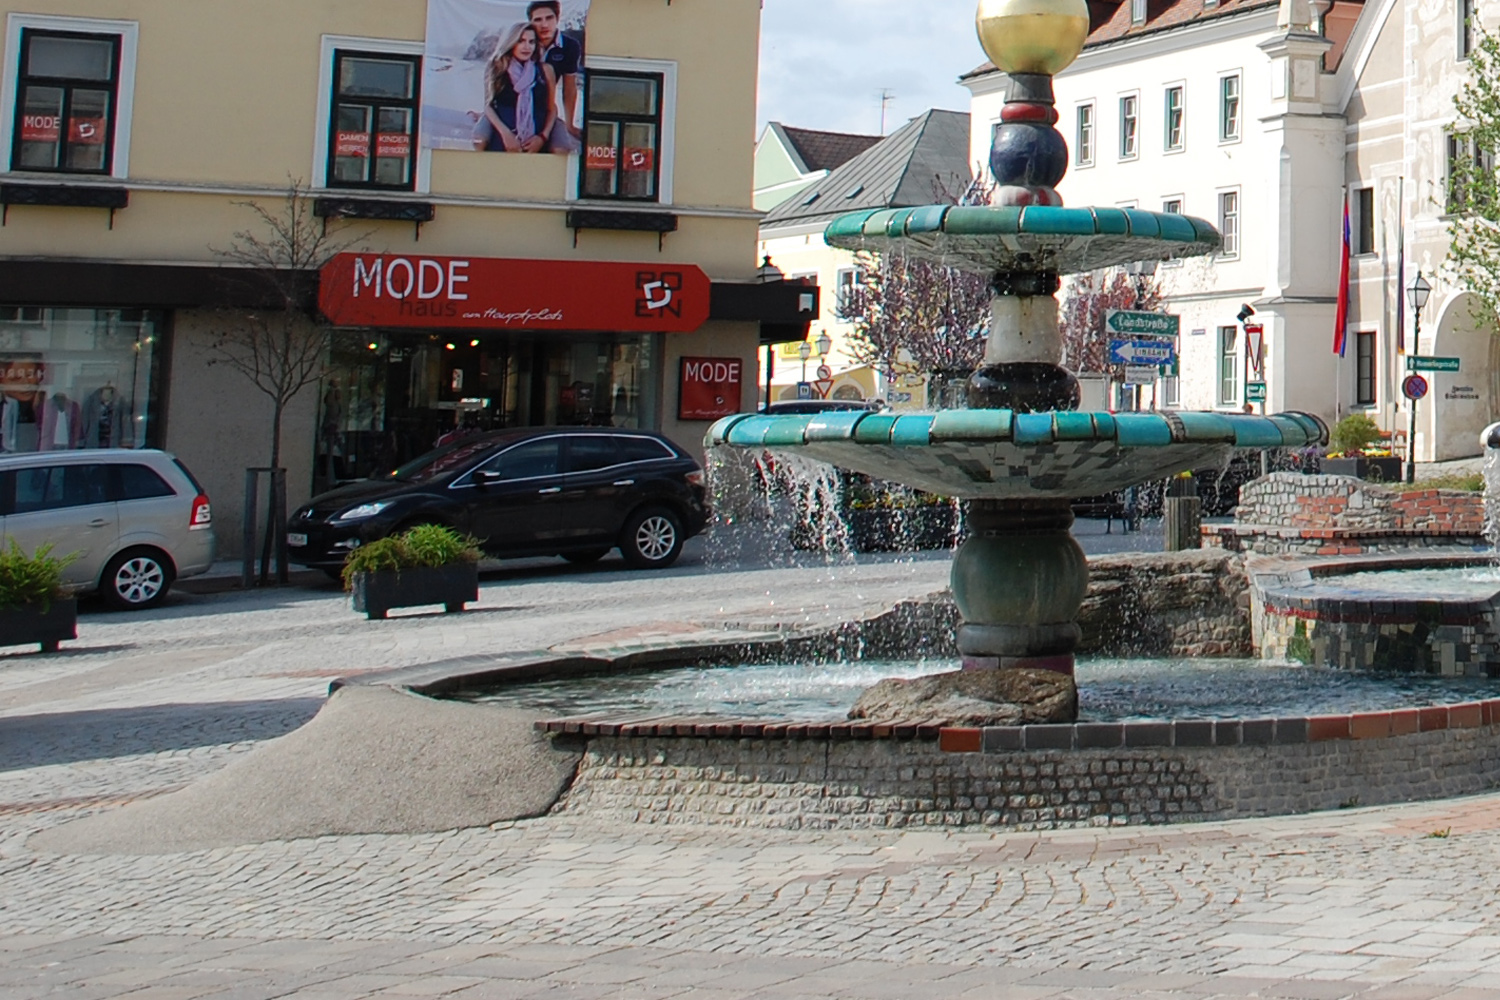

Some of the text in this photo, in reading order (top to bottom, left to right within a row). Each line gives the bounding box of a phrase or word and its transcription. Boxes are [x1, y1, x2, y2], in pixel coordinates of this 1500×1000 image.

[24, 116, 60, 129] MODE
[338, 133, 369, 142] DAMEN
[378, 135, 409, 144] KINDER
[337, 144, 369, 153] HERREN
[587, 146, 616, 158] MODE
[353, 257, 469, 300] MODE
[399, 279, 458, 318] haus
[462, 307, 563, 325] am Hauptplatz
[1118, 315, 1169, 329] Landstraße
[685, 362, 739, 383] MODE
